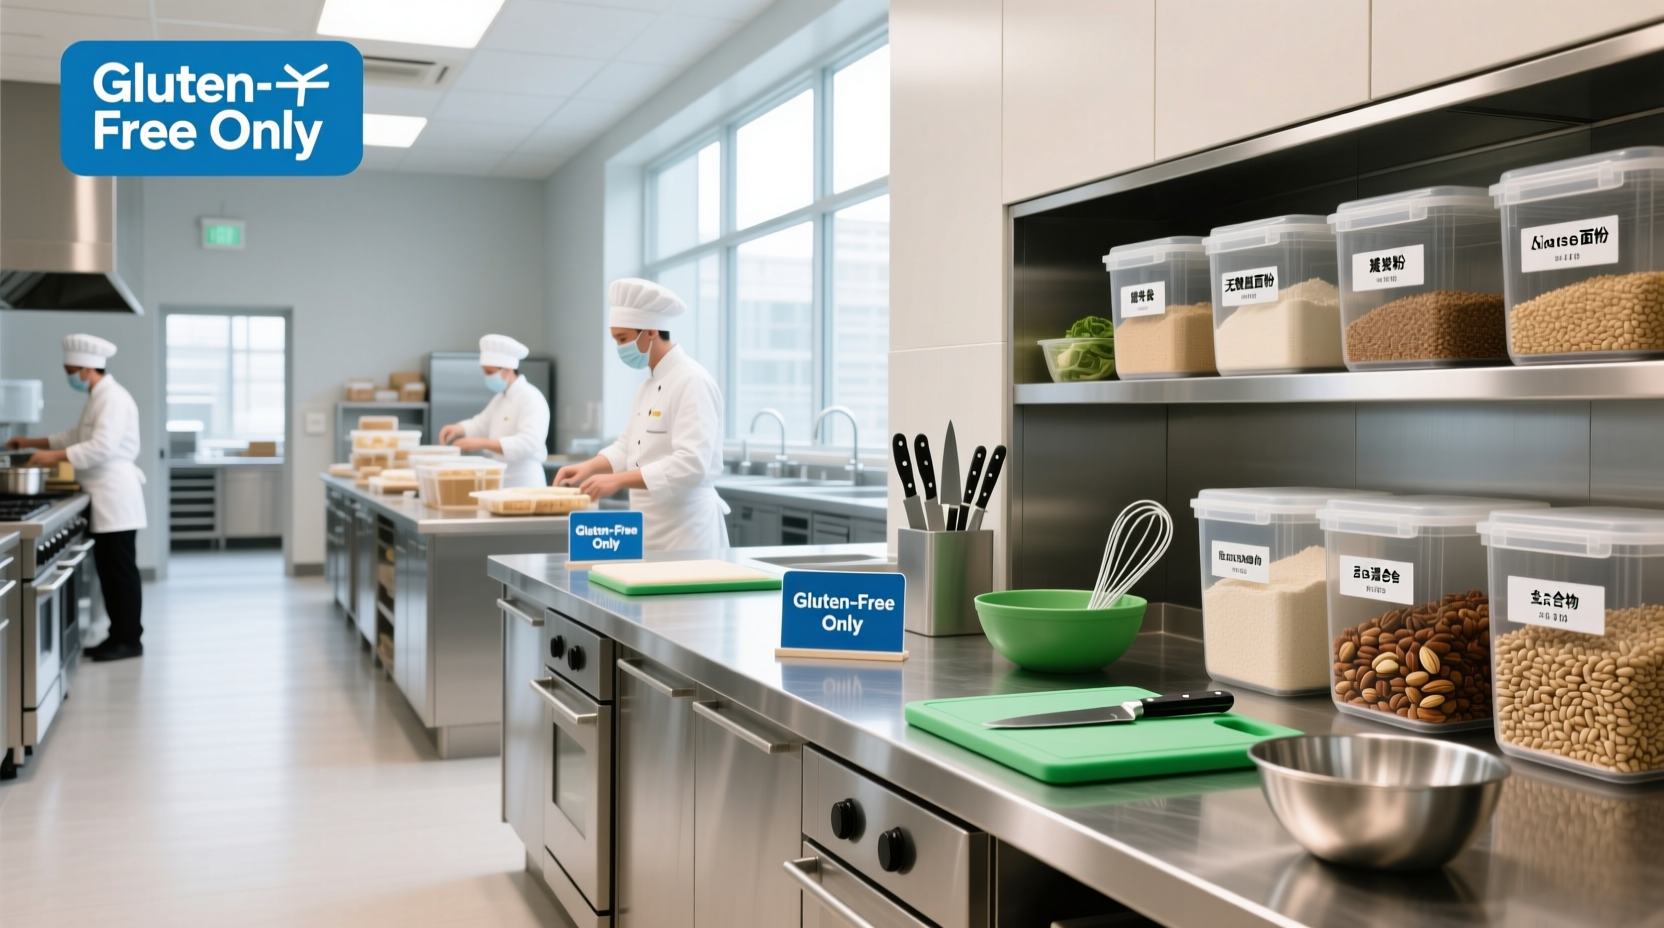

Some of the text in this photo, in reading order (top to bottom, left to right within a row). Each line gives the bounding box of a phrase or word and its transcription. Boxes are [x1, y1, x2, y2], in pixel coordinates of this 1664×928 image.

[592, 537, 621, 552] Only
[793, 591, 896, 611] Gluten-Free
[821, 614, 864, 636] Only
